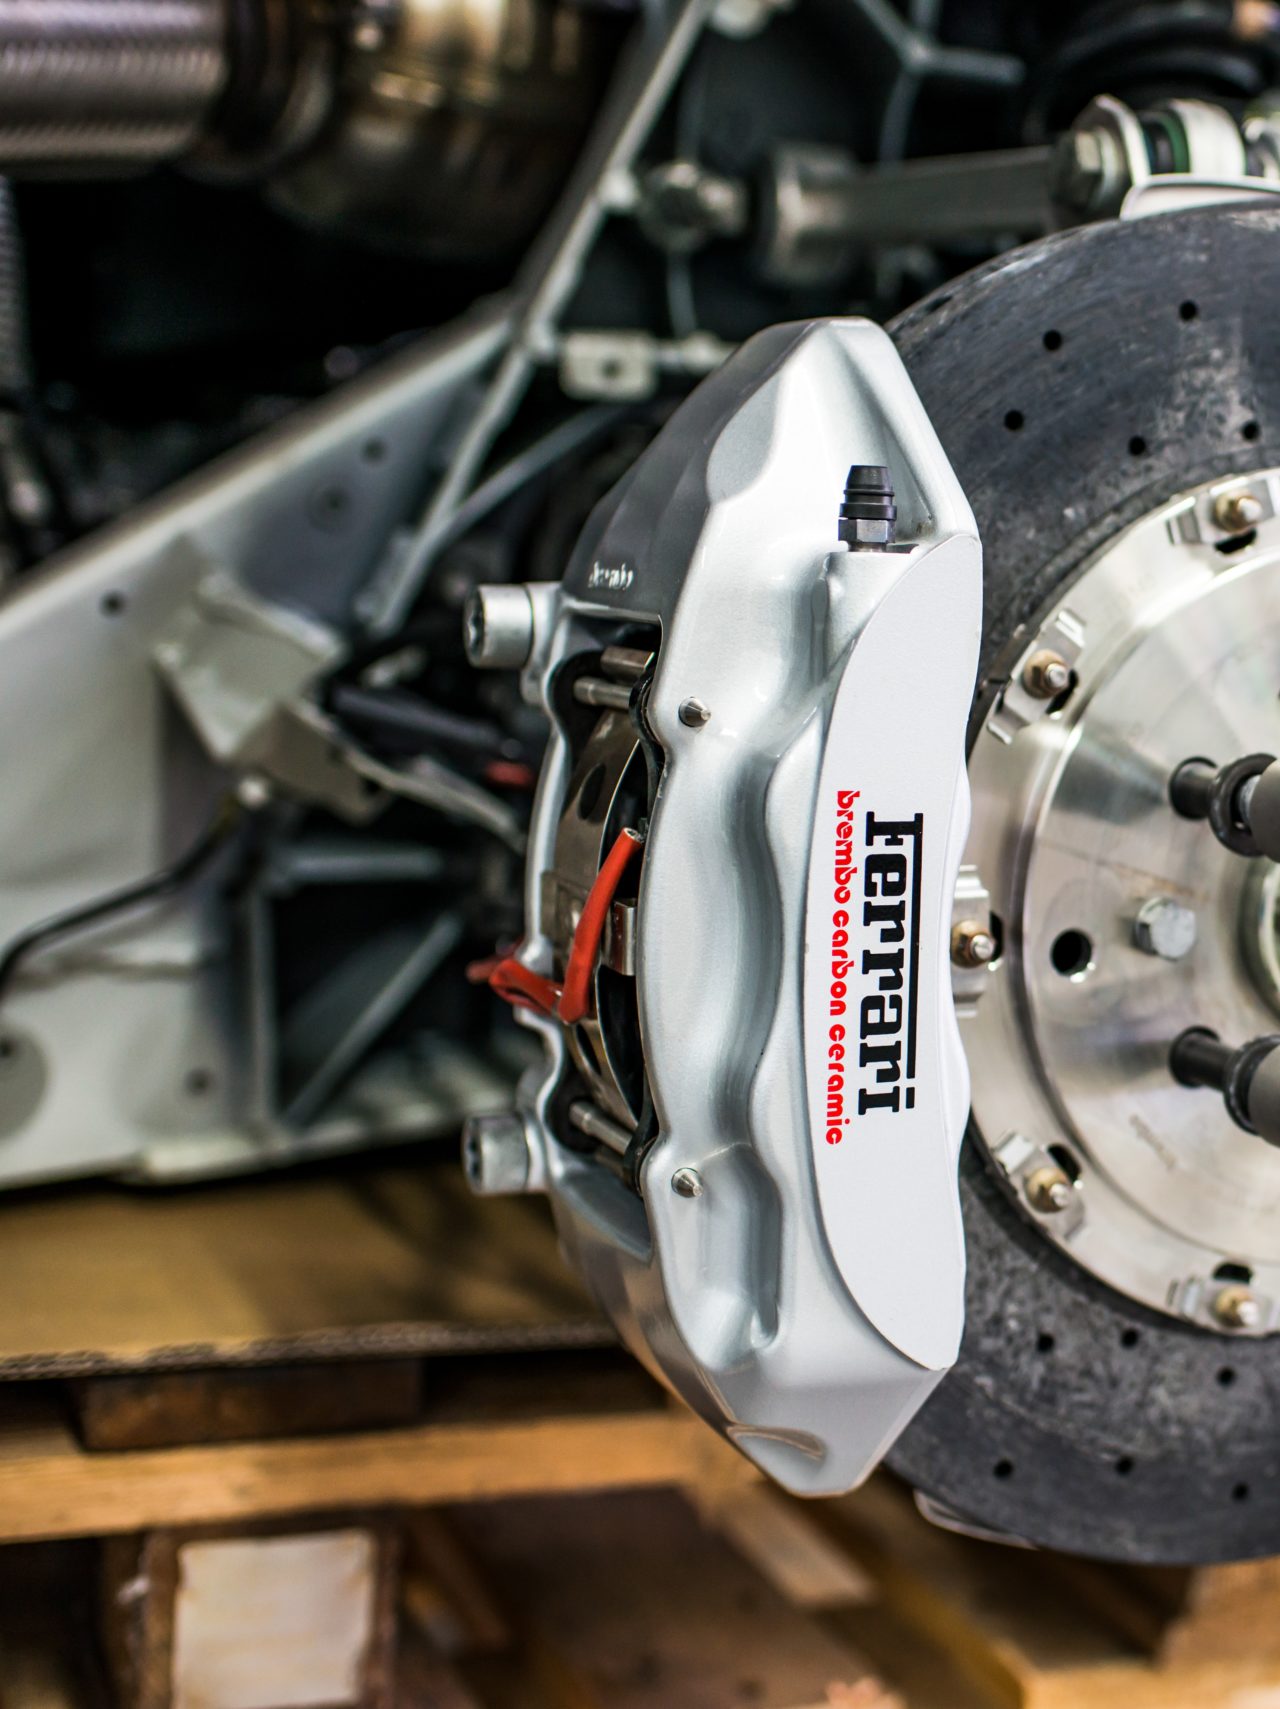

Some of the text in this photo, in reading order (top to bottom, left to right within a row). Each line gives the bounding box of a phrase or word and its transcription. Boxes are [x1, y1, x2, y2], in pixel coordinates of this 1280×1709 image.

[825, 789, 861, 1146] brembo carbon ceramic
[858, 810, 925, 1117] Ferrari
